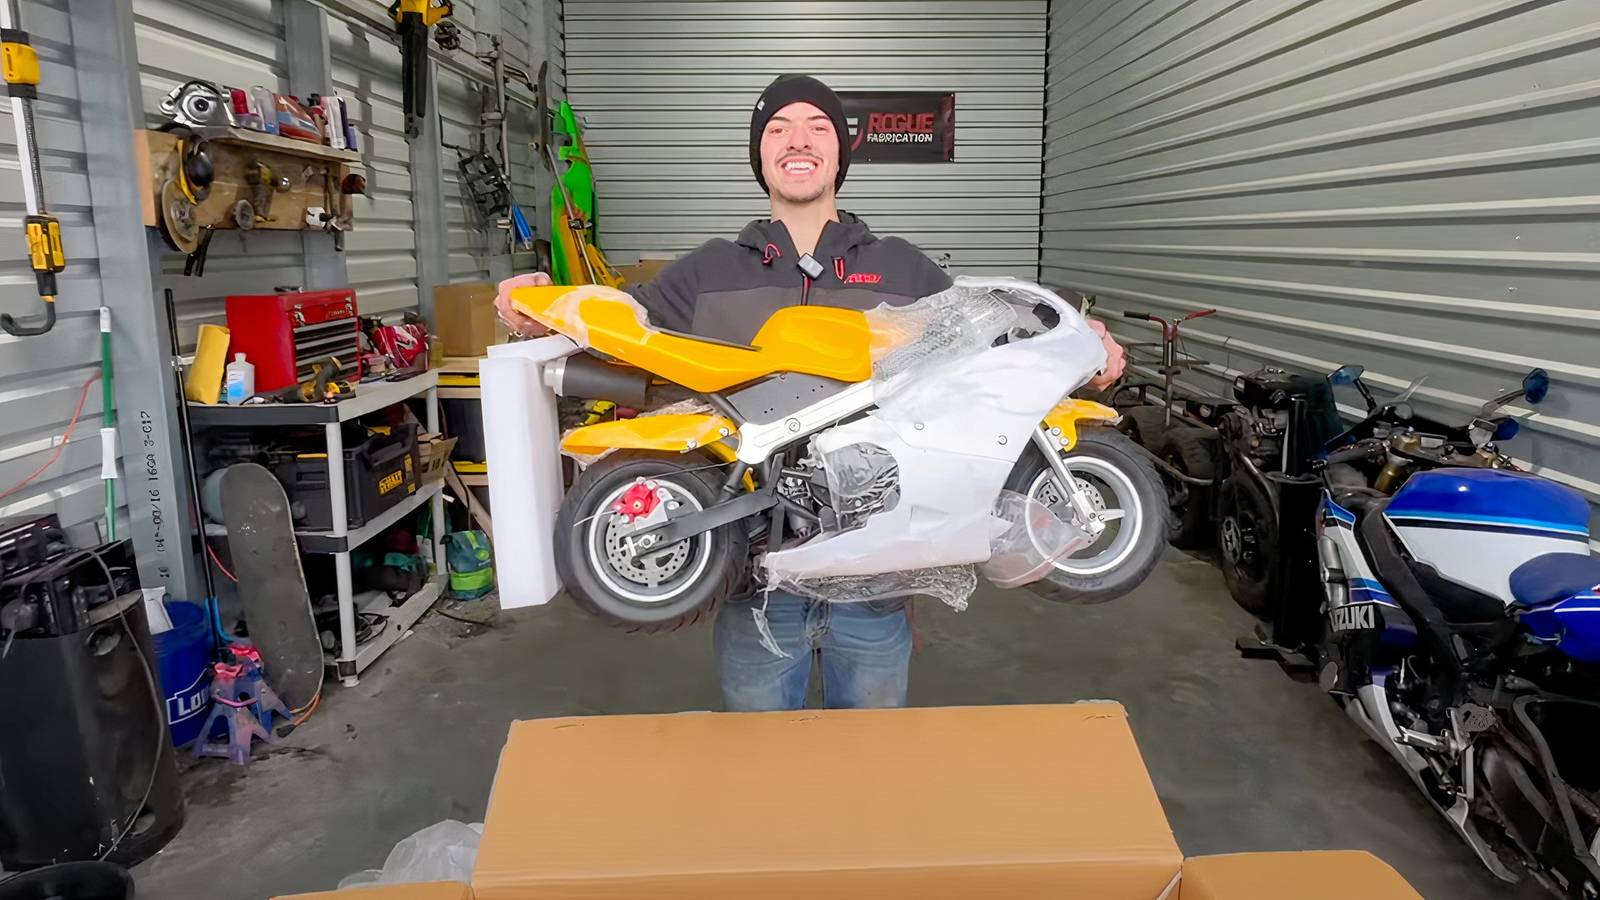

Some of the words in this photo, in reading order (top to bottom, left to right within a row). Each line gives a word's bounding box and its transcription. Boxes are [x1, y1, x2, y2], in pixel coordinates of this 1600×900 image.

[867, 114, 933, 133] ROGUE
[867, 133, 933, 144] FABRICATION
[1328, 605, 1375, 632] UZUKI
